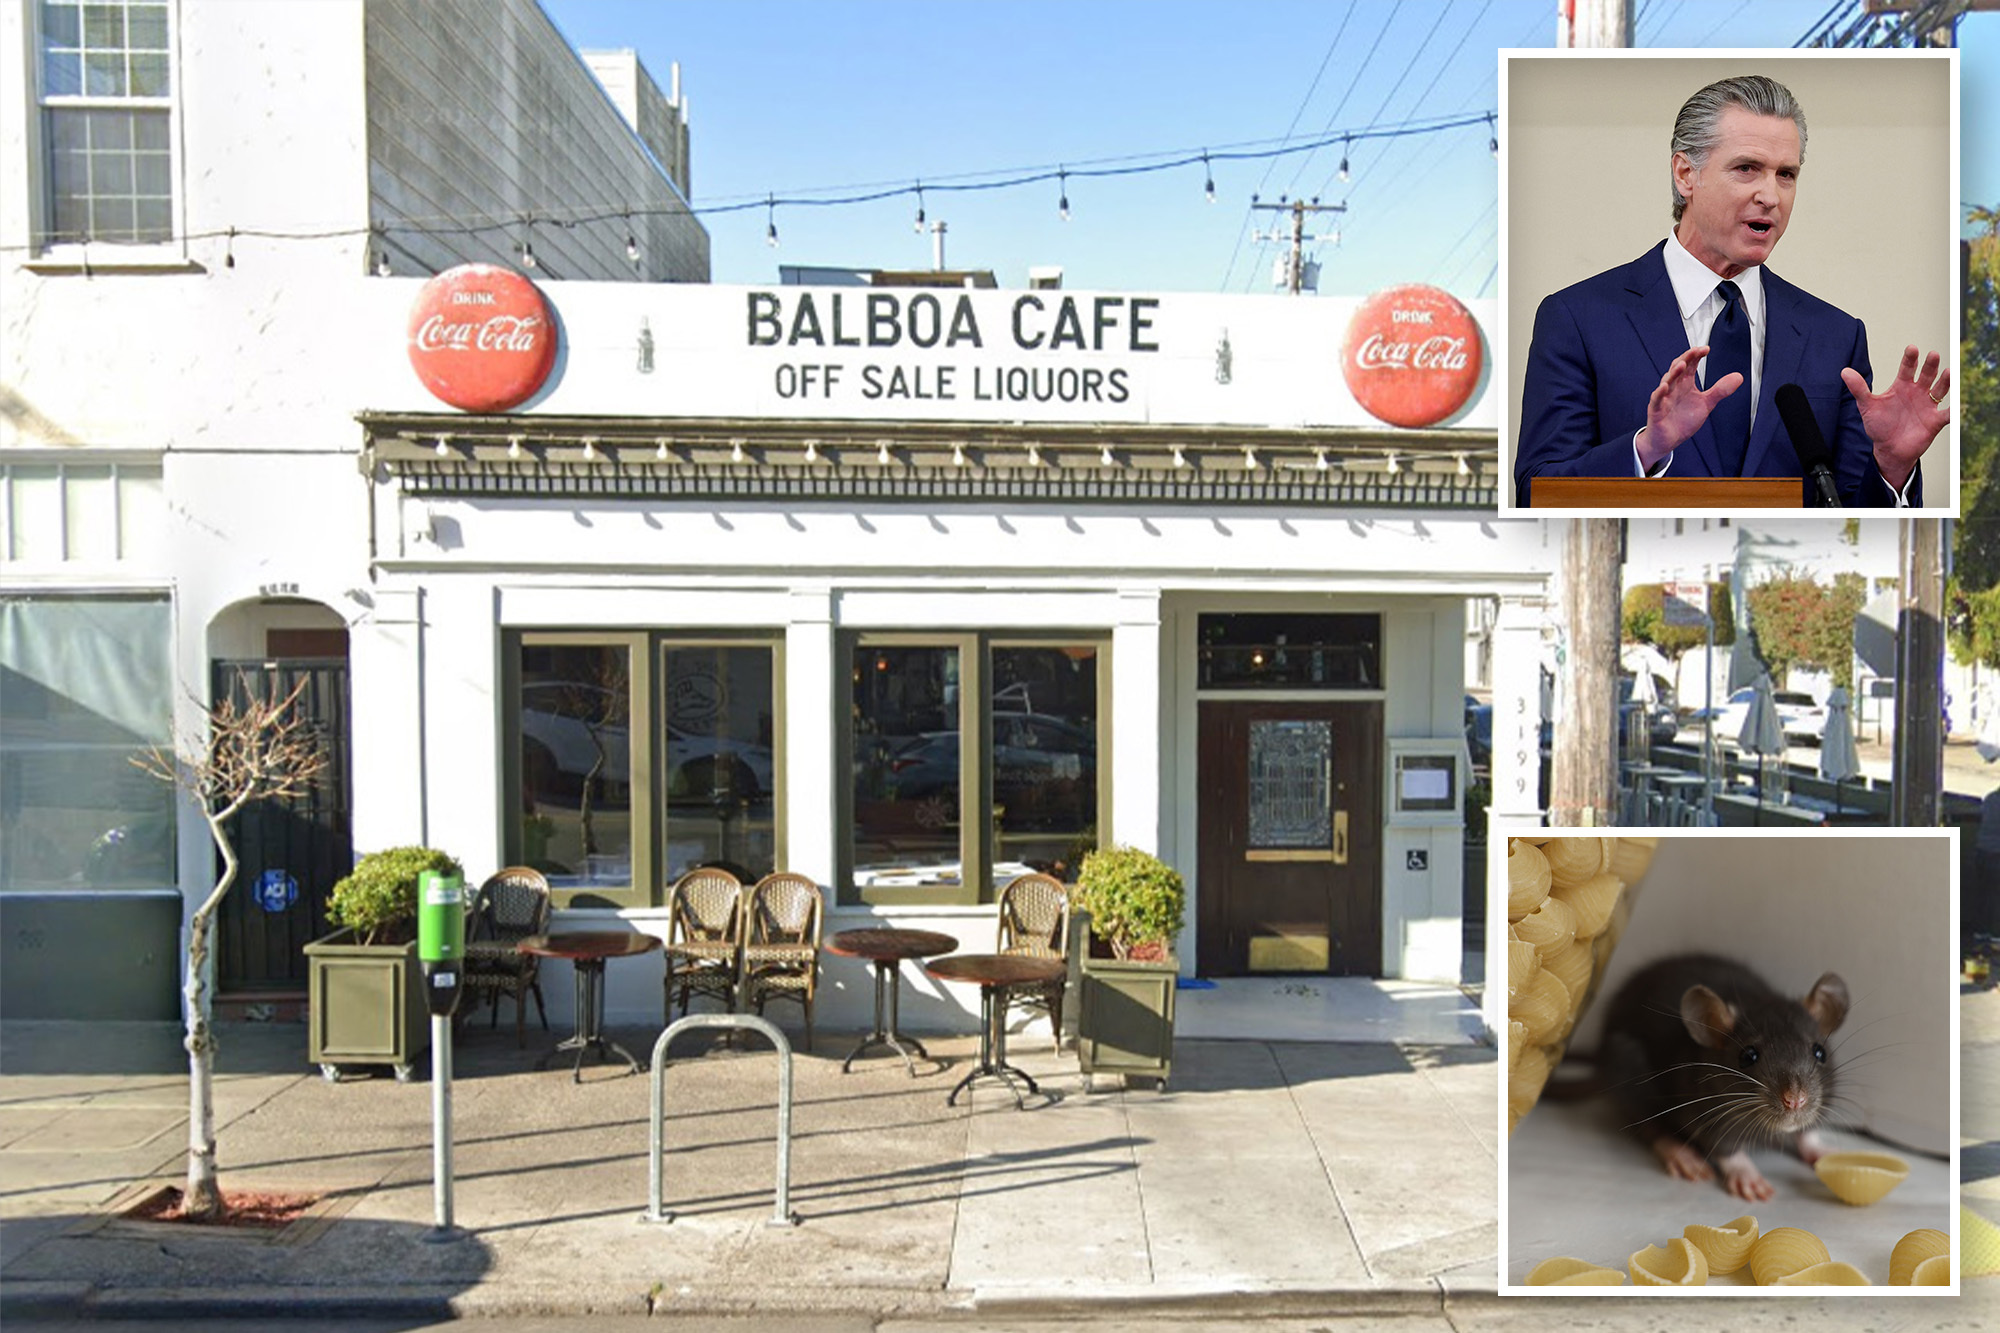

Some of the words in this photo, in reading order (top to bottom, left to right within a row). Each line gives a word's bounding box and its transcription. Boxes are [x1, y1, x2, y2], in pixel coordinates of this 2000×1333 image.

[452, 291, 497, 305] DRINK
[1391, 309, 1434, 324] DRINK
[417, 313, 541, 352] Coca-Cola
[747, 292, 983, 349] BALBOA
[1011, 294, 1160, 352] CAFE
[1356, 332, 1468, 371] Coca-Cola
[775, 363, 844, 399] OFF
[861, 364, 957, 400] SALE
[973, 366, 1130, 403] LIQUORS
[1514, 697, 1527, 794] 3199
